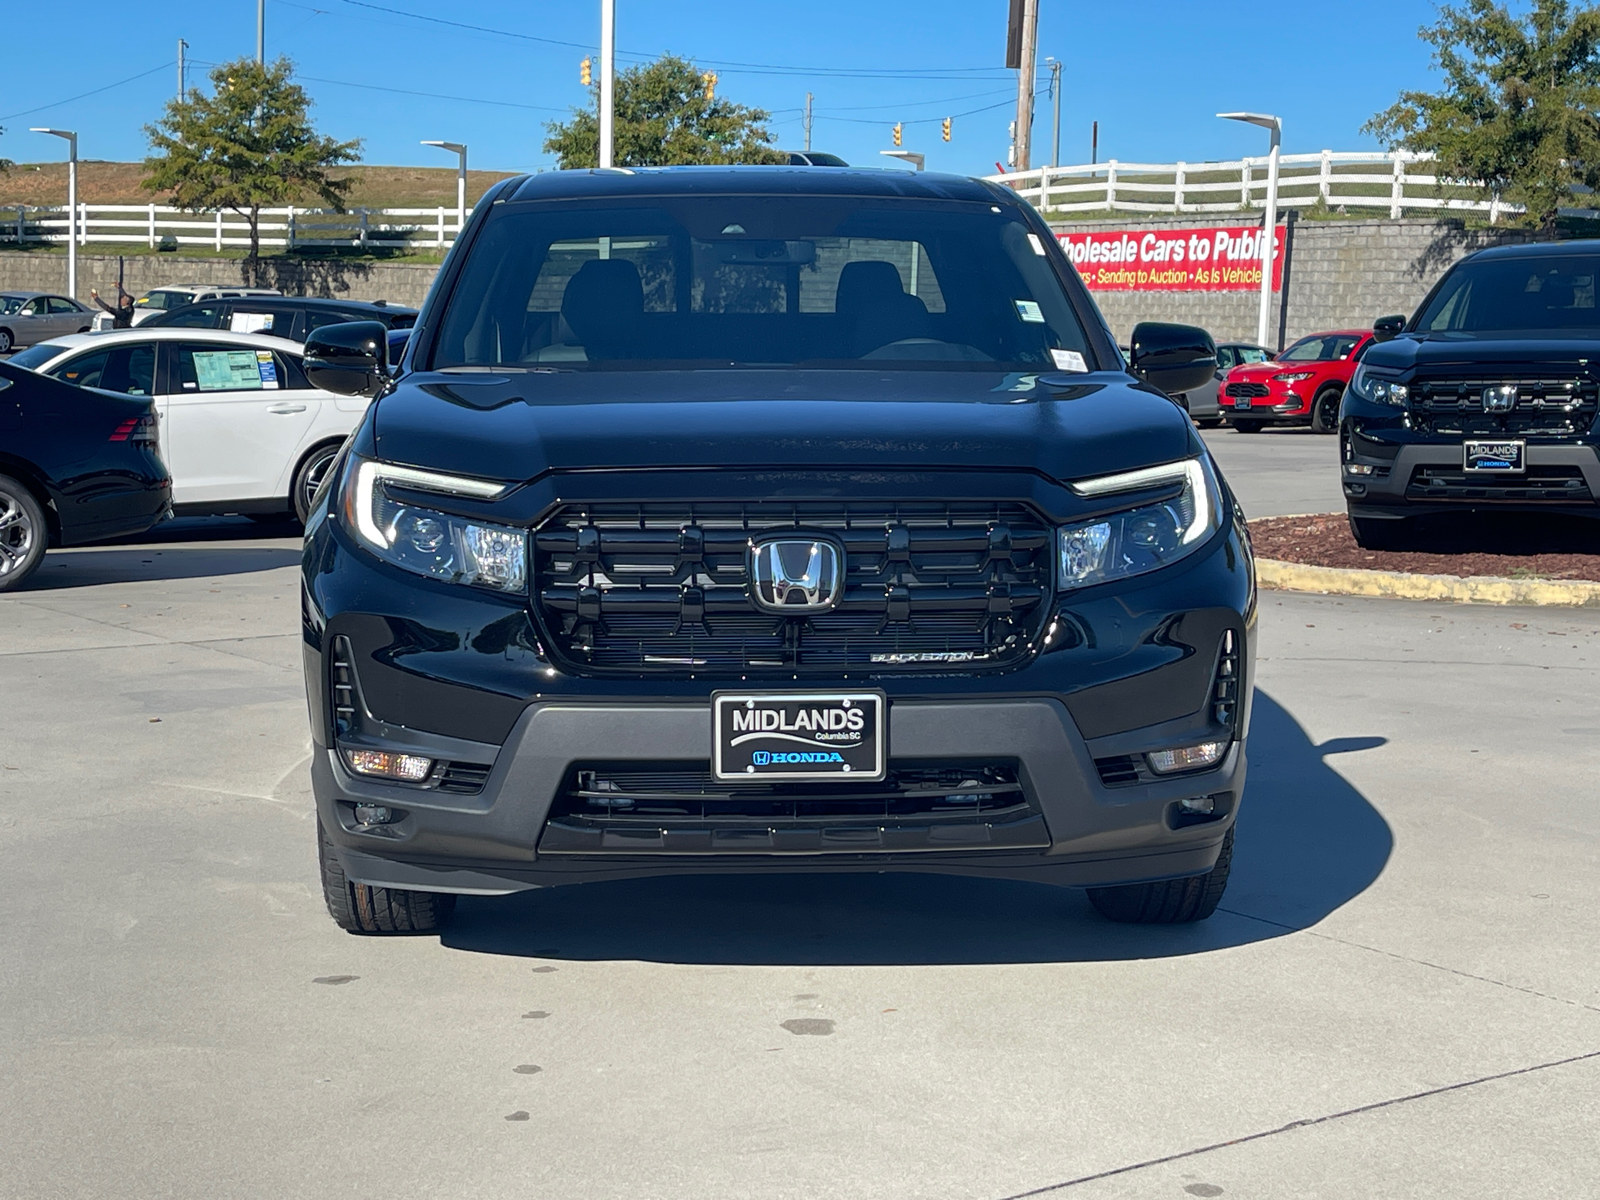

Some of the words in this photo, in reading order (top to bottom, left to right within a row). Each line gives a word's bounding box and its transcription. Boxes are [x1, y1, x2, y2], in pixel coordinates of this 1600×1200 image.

[1141, 232, 1186, 262] Cars
[1188, 234, 1211, 261] to
[1079, 272, 1092, 284] rs
[1097, 268, 1136, 287] Sending
[1137, 269, 1149, 284] to
[1149, 267, 1188, 284] Auction
[1195, 267, 1209, 283] As
[1211, 267, 1220, 283] Is
[1222, 266, 1262, 284] Vehicle
[1469, 446, 1518, 455] MIDLANDS
[920, 651, 974, 662] EDITION
[733, 708, 864, 732] MIDLANDS
[815, 732, 849, 740] Columbia
[849, 731, 861, 740] SC
[771, 752, 845, 763] HONDA
